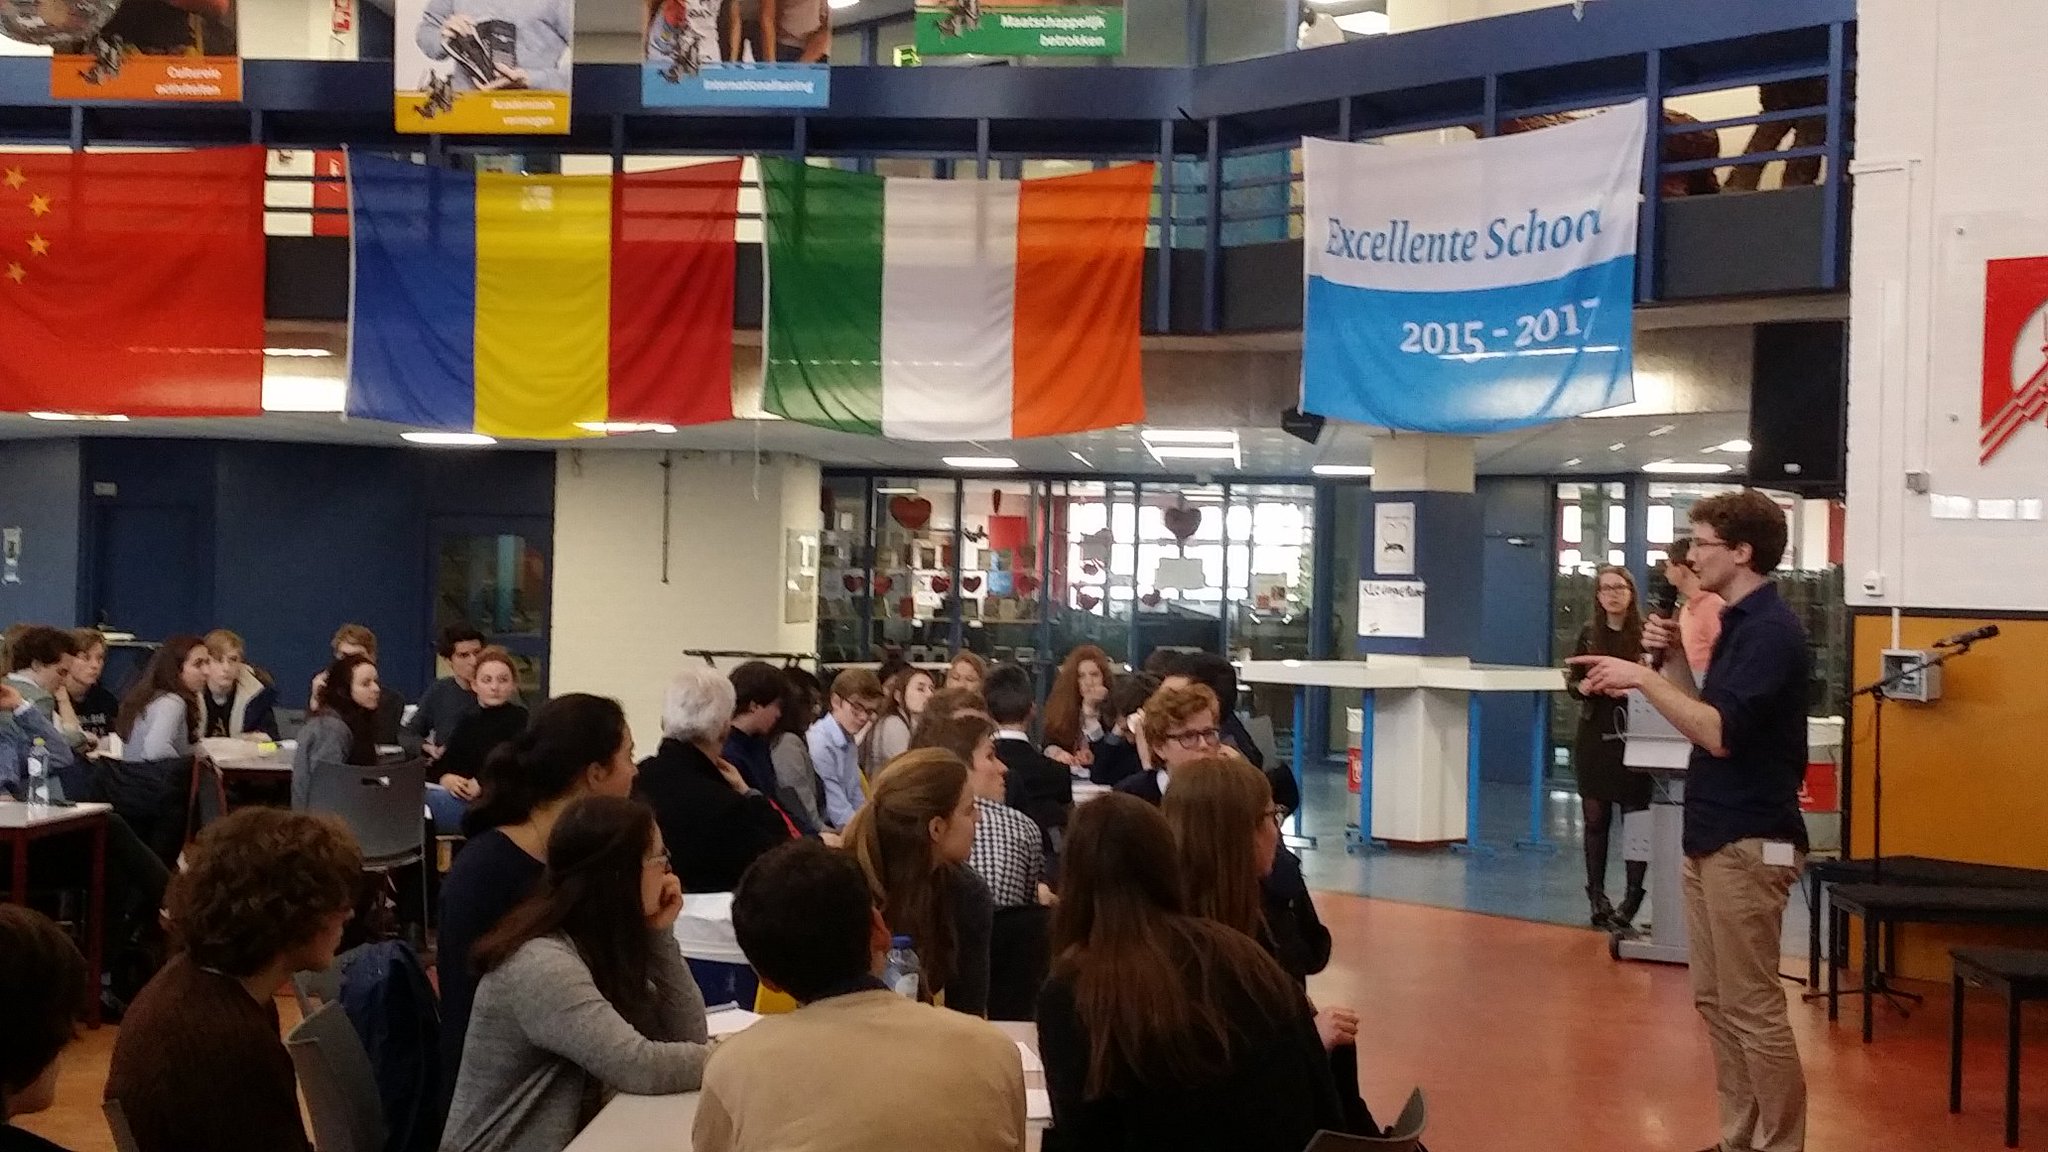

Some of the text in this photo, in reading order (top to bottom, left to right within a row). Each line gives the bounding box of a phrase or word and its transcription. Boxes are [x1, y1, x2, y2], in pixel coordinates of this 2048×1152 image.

[1001, 15, 1105, 31] Maatschappelijk
[1040, 34, 1105, 47] betrokken
[1326, 217, 1478, 263] Excellente
[1401, 321, 1485, 362] 2015
[1514, 296, 1600, 346] 2017
